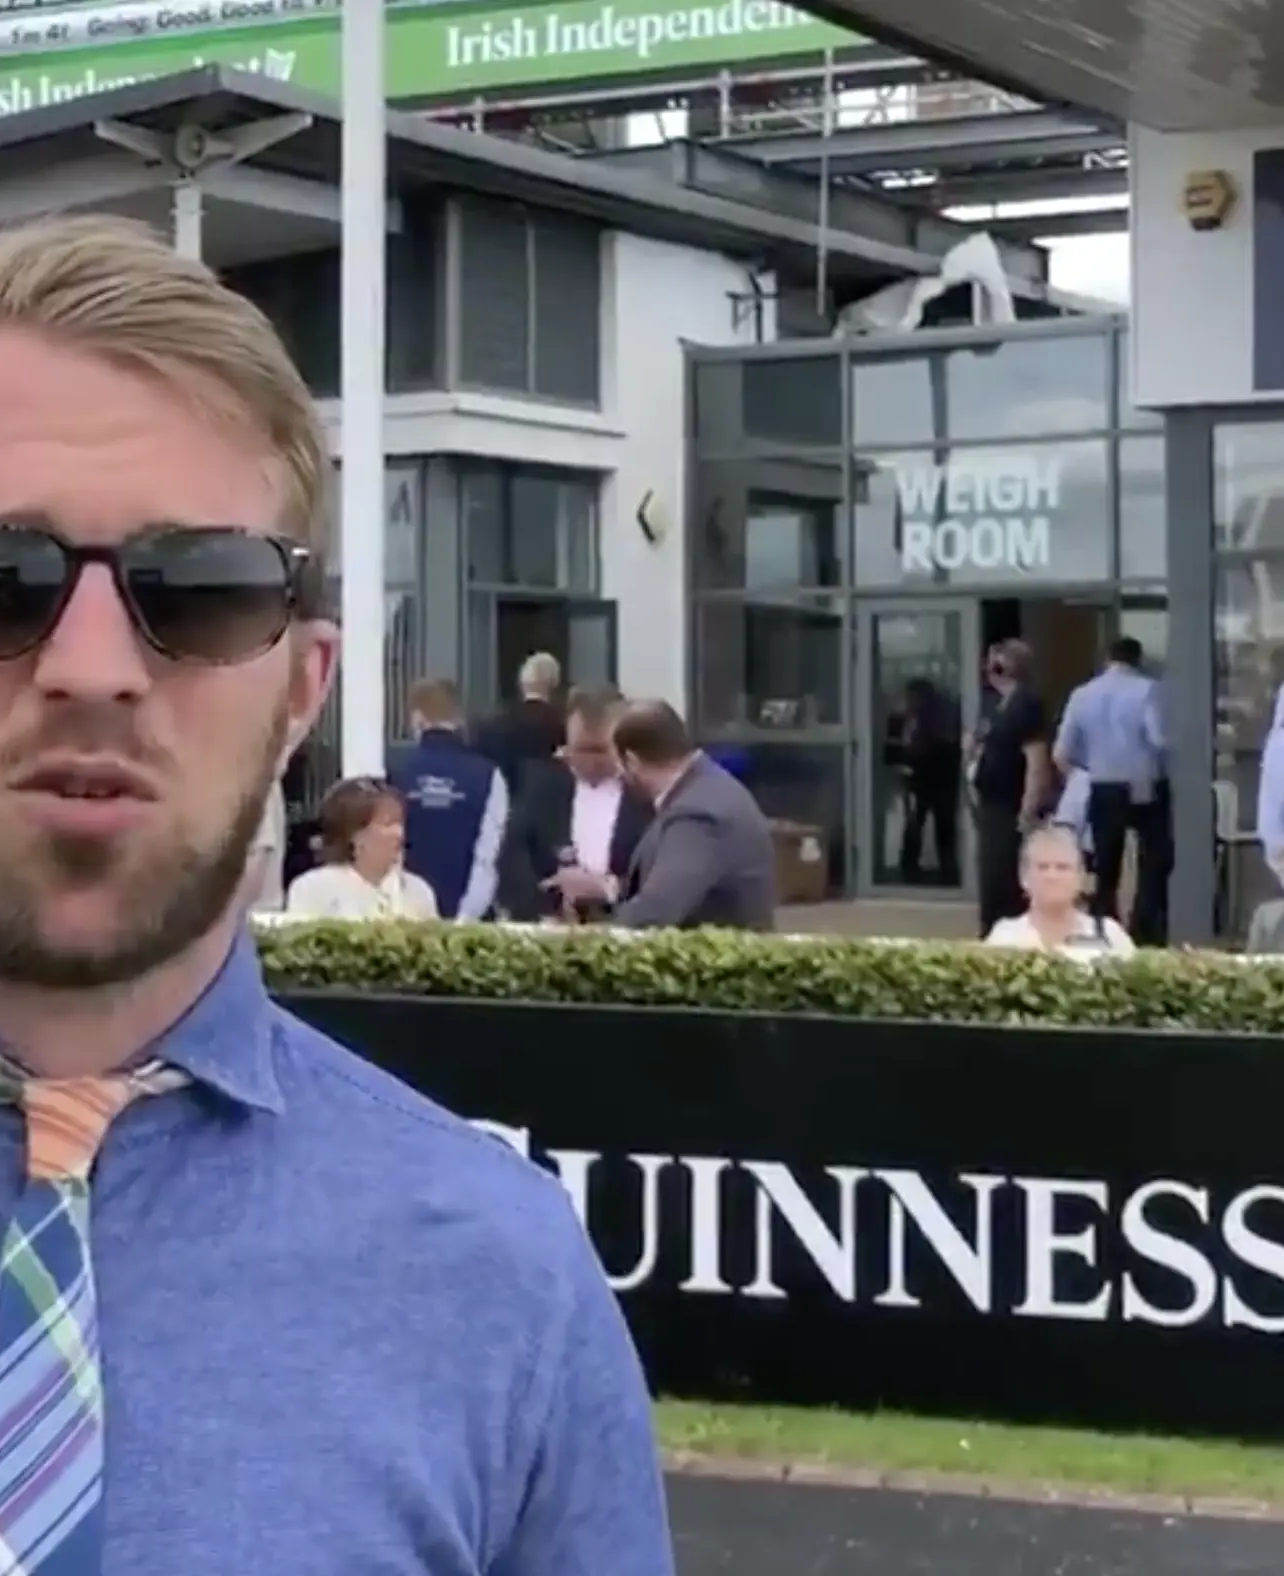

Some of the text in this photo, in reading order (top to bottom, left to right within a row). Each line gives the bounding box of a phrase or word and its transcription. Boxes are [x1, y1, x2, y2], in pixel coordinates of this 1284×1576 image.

[447, 15, 536, 67] Irish
[894, 454, 1060, 514] WEIGH
[901, 515, 1051, 572] ROOM
[466, 1119, 1284, 1333] UINNESS
